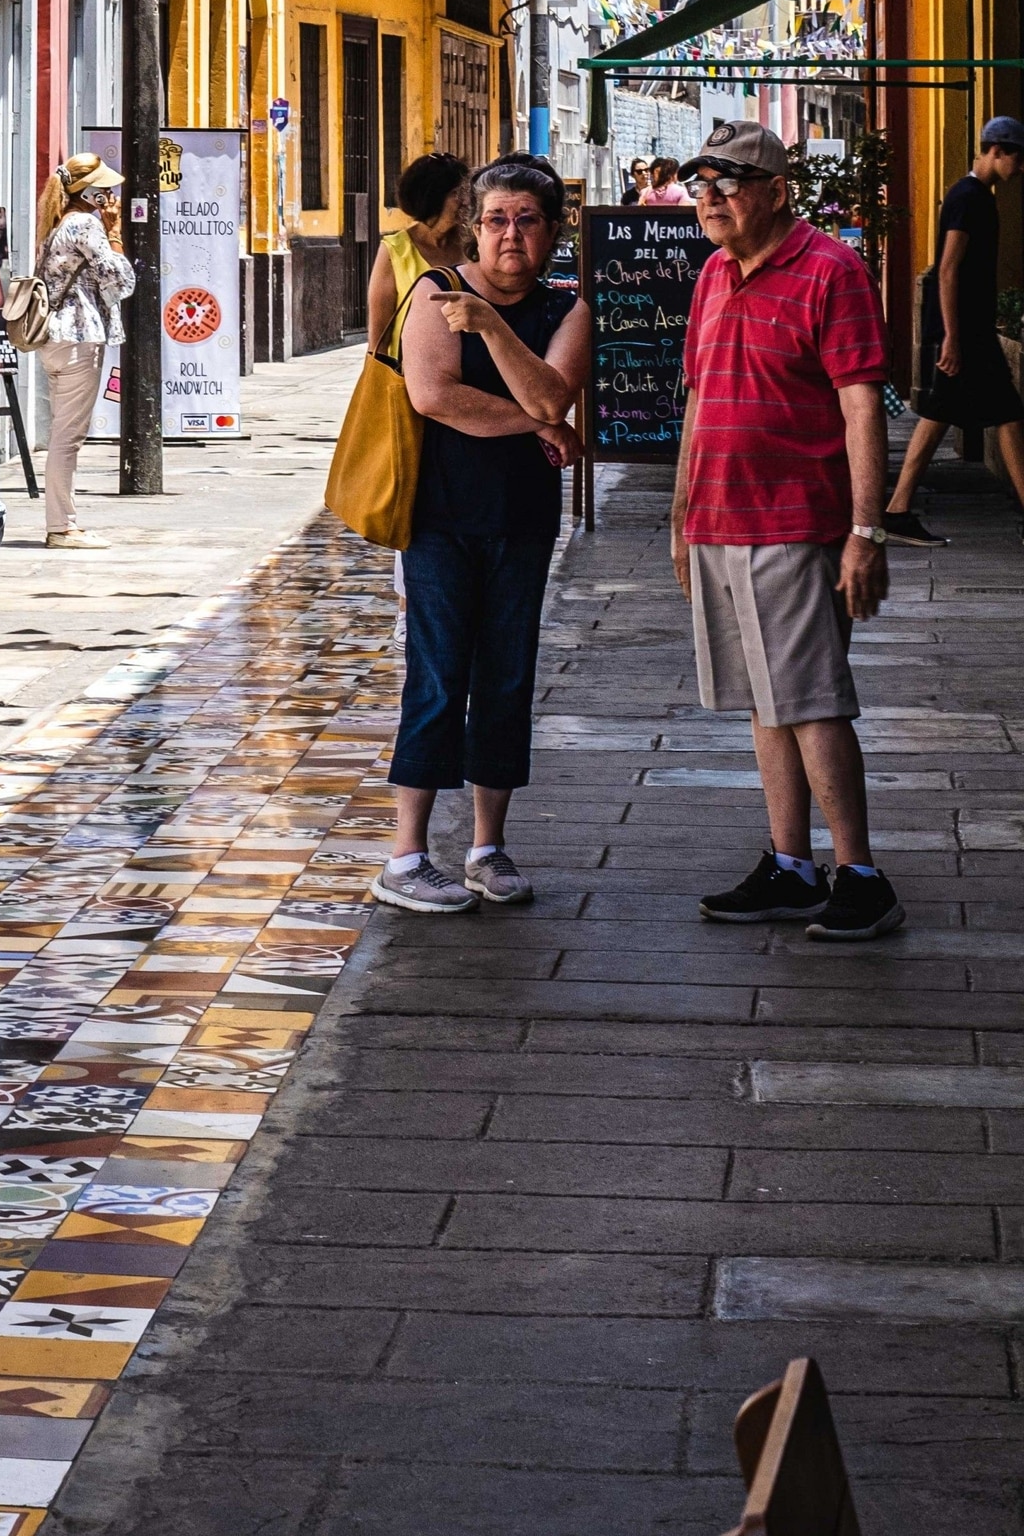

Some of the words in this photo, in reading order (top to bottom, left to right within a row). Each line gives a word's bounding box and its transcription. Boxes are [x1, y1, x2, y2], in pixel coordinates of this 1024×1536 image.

[176, 201, 219, 216] HELADO
[162, 220, 176, 235] EN
[179, 220, 234, 235] ROLLITOS
[634, 248, 659, 260] DEL
[605, 259, 652, 286] Chupe
[656, 262, 674, 280] de
[610, 307, 649, 332] Causa
[180, 362, 207, 376] ROLL
[165, 380, 223, 395] SANDWICH
[613, 371, 659, 394] Chuleta
[612, 397, 651, 421] Lomo
[610, 421, 672, 446] Pescado
